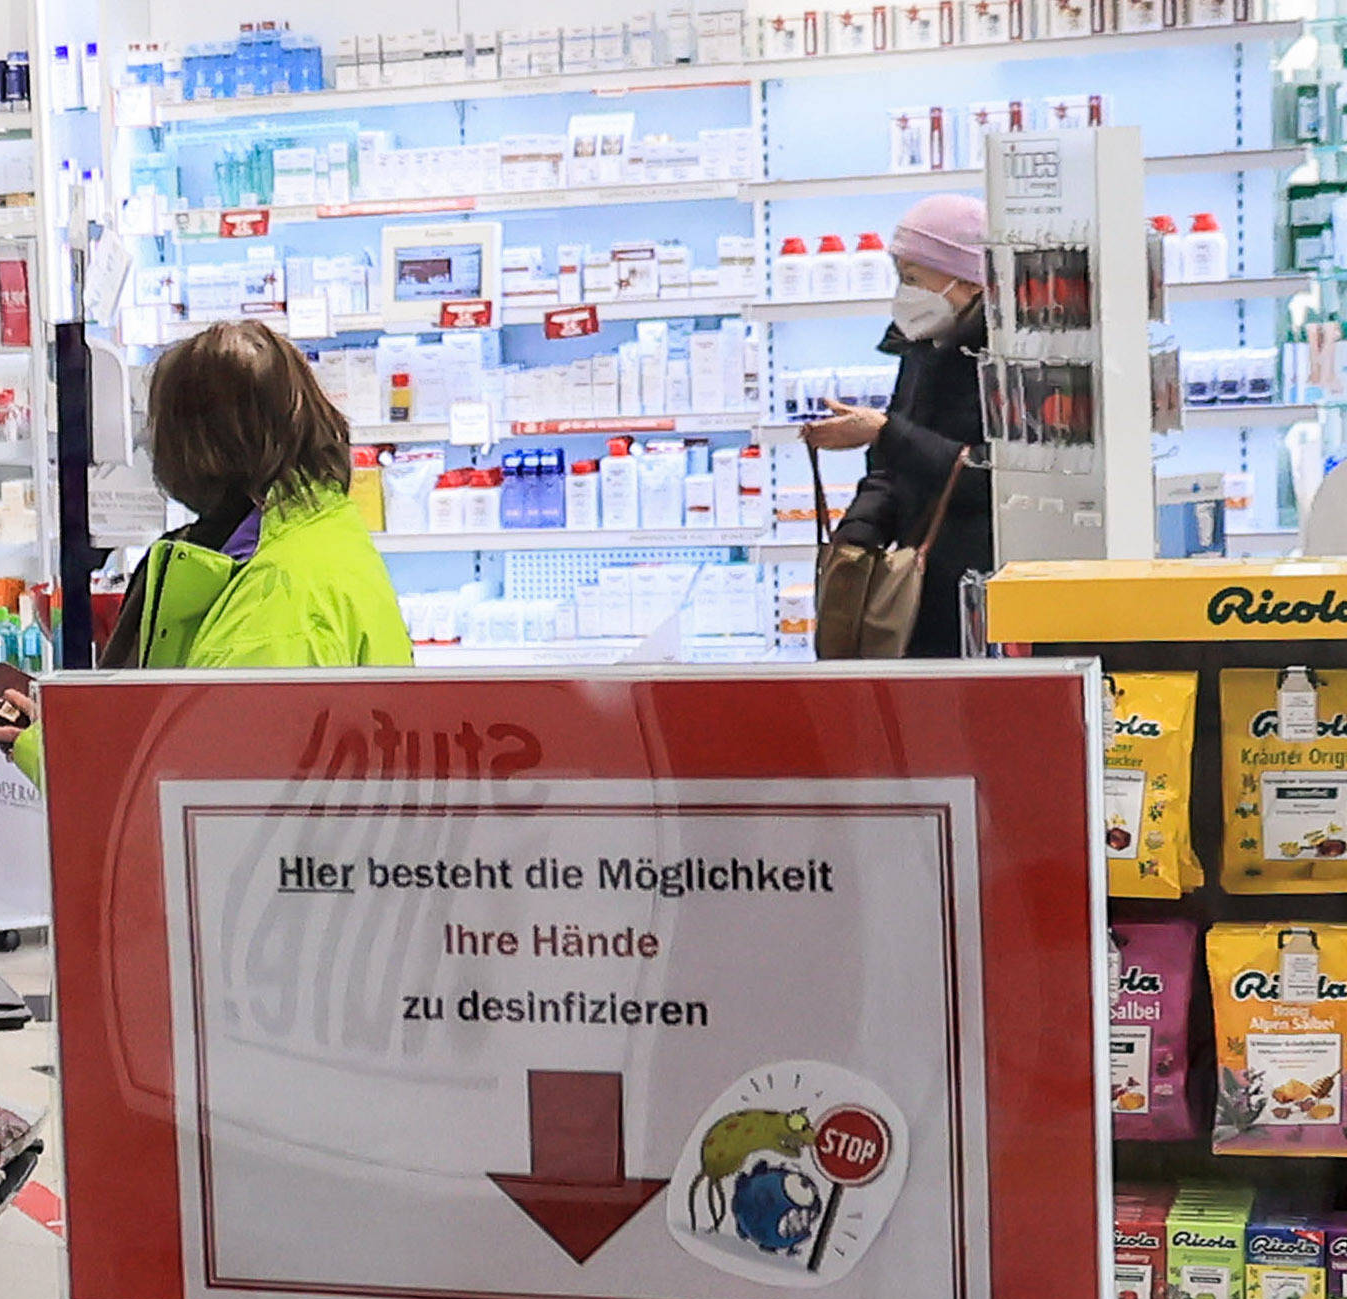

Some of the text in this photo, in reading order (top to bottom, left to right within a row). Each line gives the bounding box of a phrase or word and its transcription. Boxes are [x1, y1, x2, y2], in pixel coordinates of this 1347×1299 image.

[1241, 747, 1347, 769] Kräuter Orig
[277, 856, 833, 898] Hier besteht die Möglichkeit
[444, 924, 659, 959] Ihre Hände
[1234, 972, 1347, 1000] Rila
[403, 990, 707, 1028] zu desinfizieren
[820, 1128, 876, 1165] STOP
[1115, 1231, 1157, 1247] icola
[1173, 1231, 1237, 1249] Ricola
[1252, 1238, 1319, 1255] Ricola
